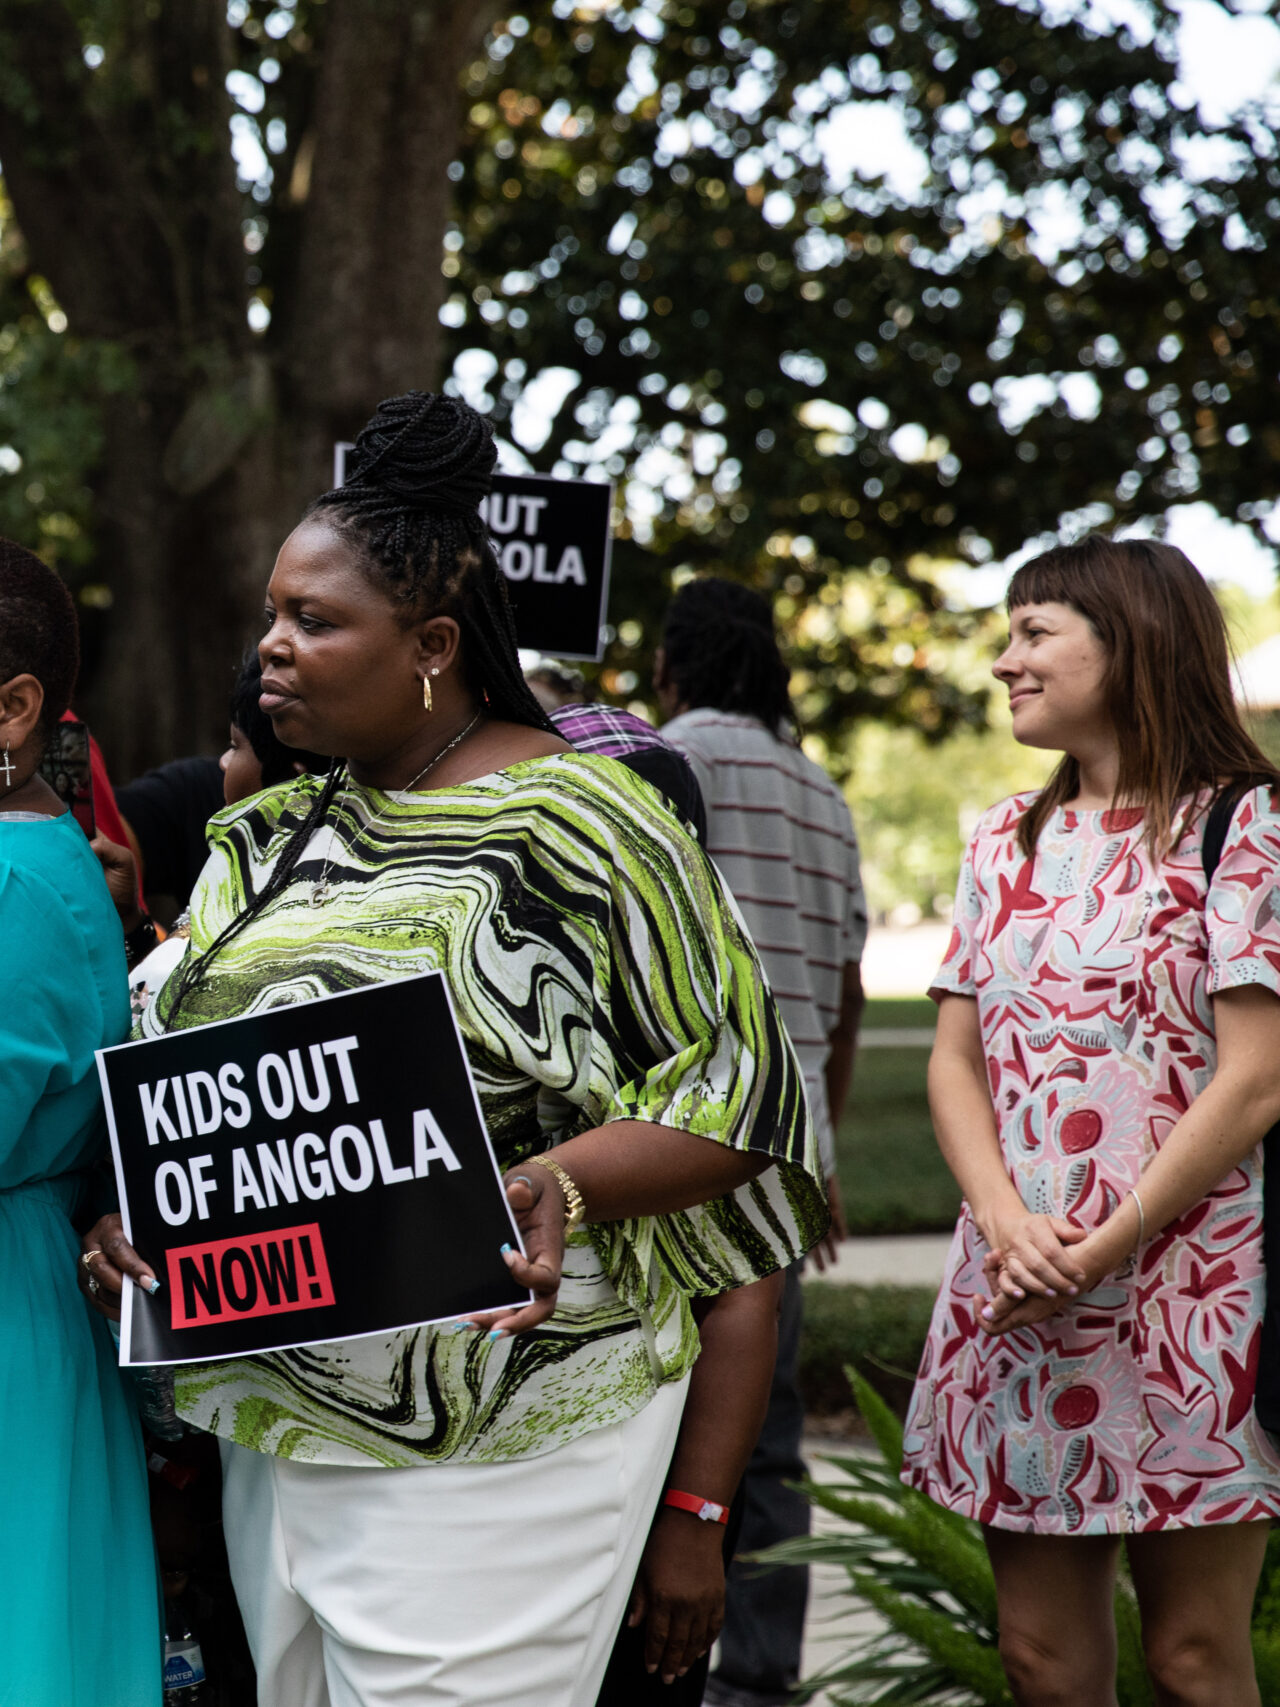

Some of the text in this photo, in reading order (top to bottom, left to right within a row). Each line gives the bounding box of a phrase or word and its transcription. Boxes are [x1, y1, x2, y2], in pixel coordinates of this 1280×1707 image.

[488, 538, 587, 585] OLA
[138, 1035, 360, 1146] KIDS OUT
[154, 1108, 462, 1227] OF ANGOLA
[179, 1235, 323, 1320] NOW!
